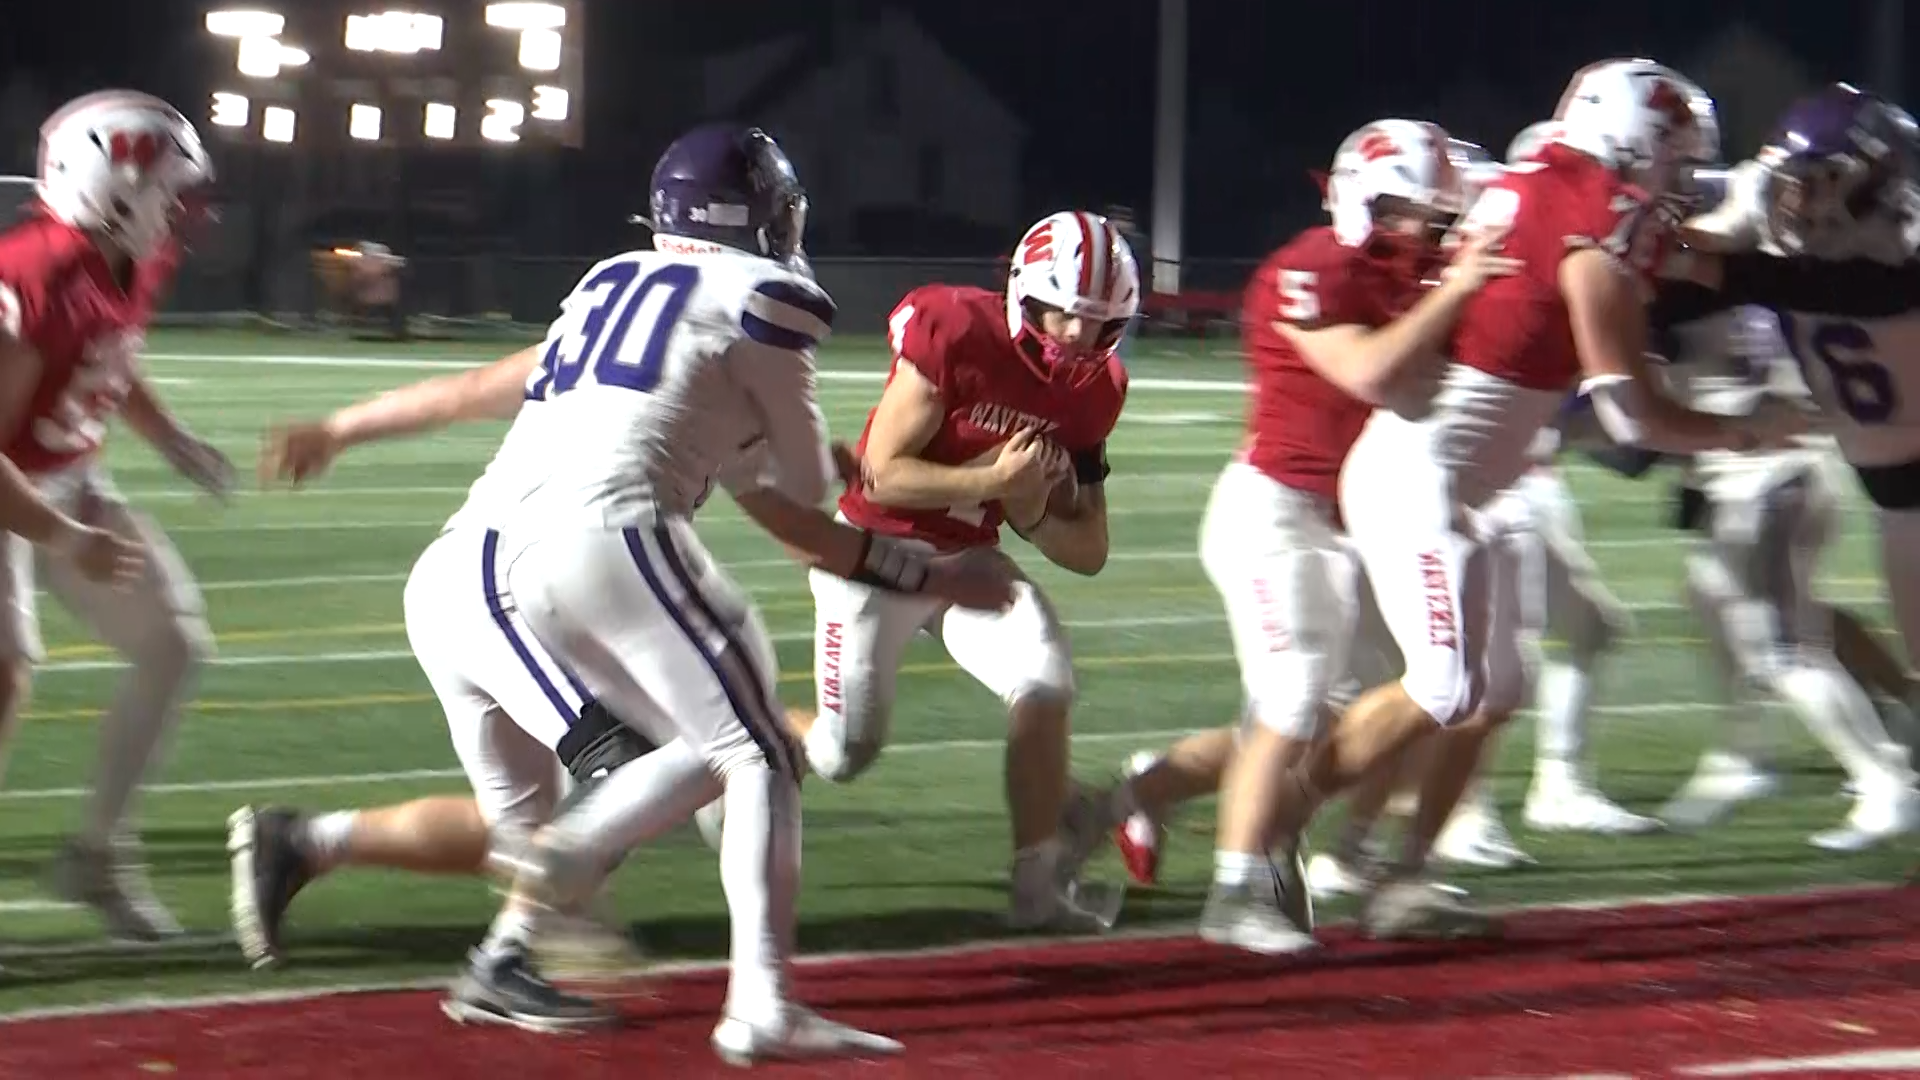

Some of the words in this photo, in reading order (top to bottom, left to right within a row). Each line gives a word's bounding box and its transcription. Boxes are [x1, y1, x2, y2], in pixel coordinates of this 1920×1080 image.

[1024, 222, 1054, 266] W
[1277, 269, 1321, 319] 5
[538, 261, 699, 400] 30
[822, 621, 844, 714] WAVERLY
